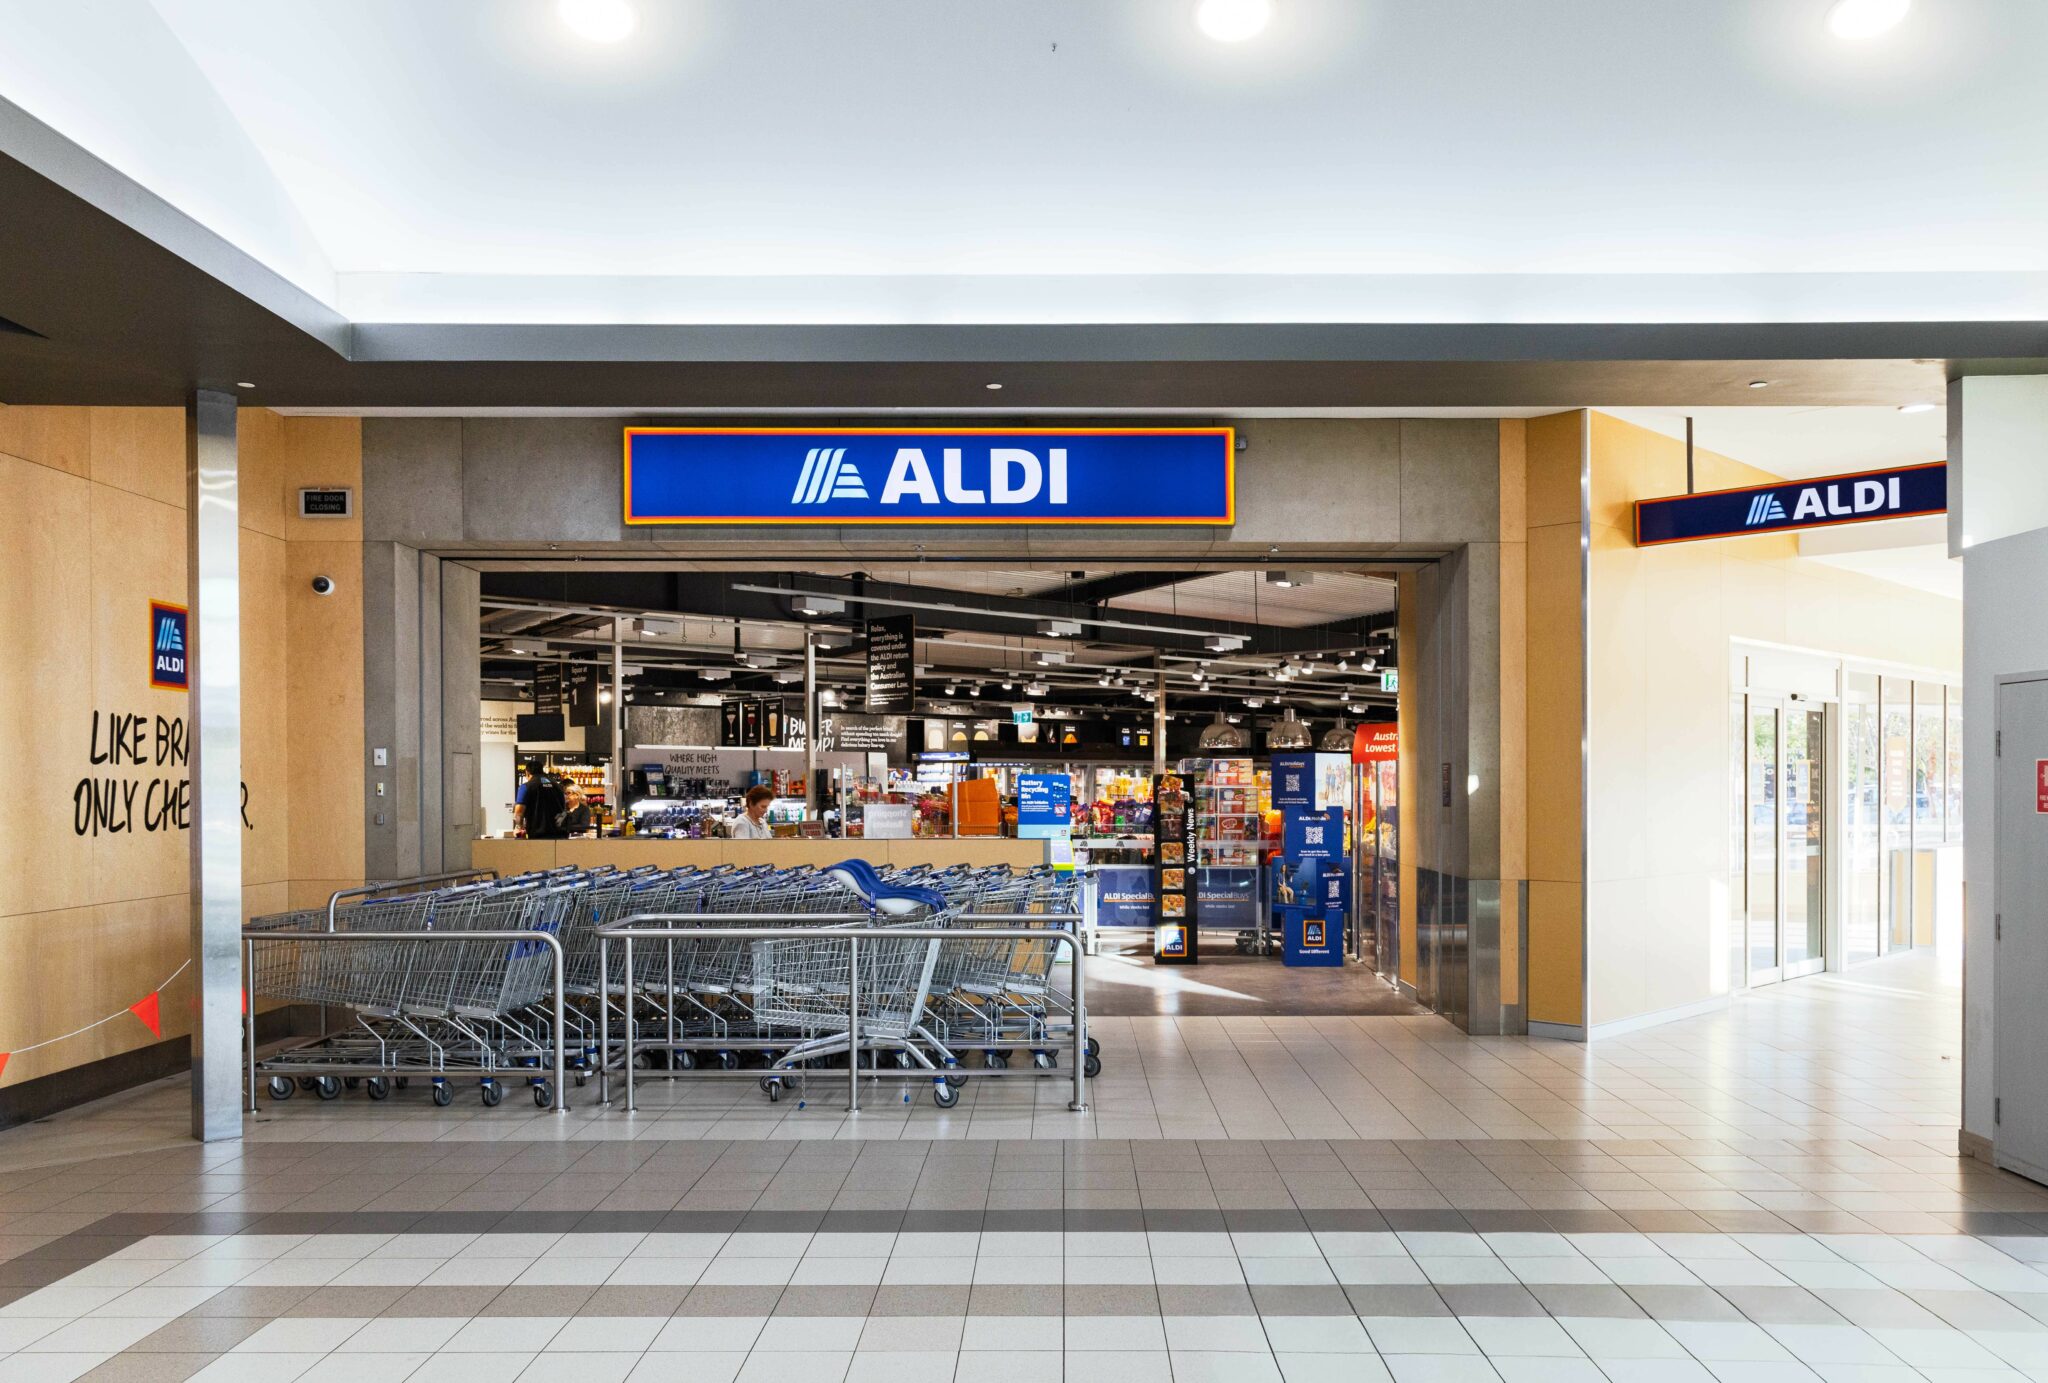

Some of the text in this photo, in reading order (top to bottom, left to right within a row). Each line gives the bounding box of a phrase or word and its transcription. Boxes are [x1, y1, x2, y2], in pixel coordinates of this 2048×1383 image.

[881, 449, 1067, 503] ALDI
[1793, 478, 1899, 519] ALDI
[871, 634, 898, 642] everything
[156, 655, 184, 673] ALDI
[871, 663, 886, 672] policy
[880, 672, 905, 680] Australian
[871, 682, 896, 690] Consumer
[572, 688, 577, 705] 1
[90, 710, 147, 765] LIKE
[1365, 744, 1396, 752] Lowest
[669, 753, 717, 763] WHERE HIGH
[665, 765, 720, 775] QUALITY MEETS
[1021, 780, 1043, 788] Battery
[74, 778, 139, 837] ONLY
[1187, 831, 1197, 862] Weekly
